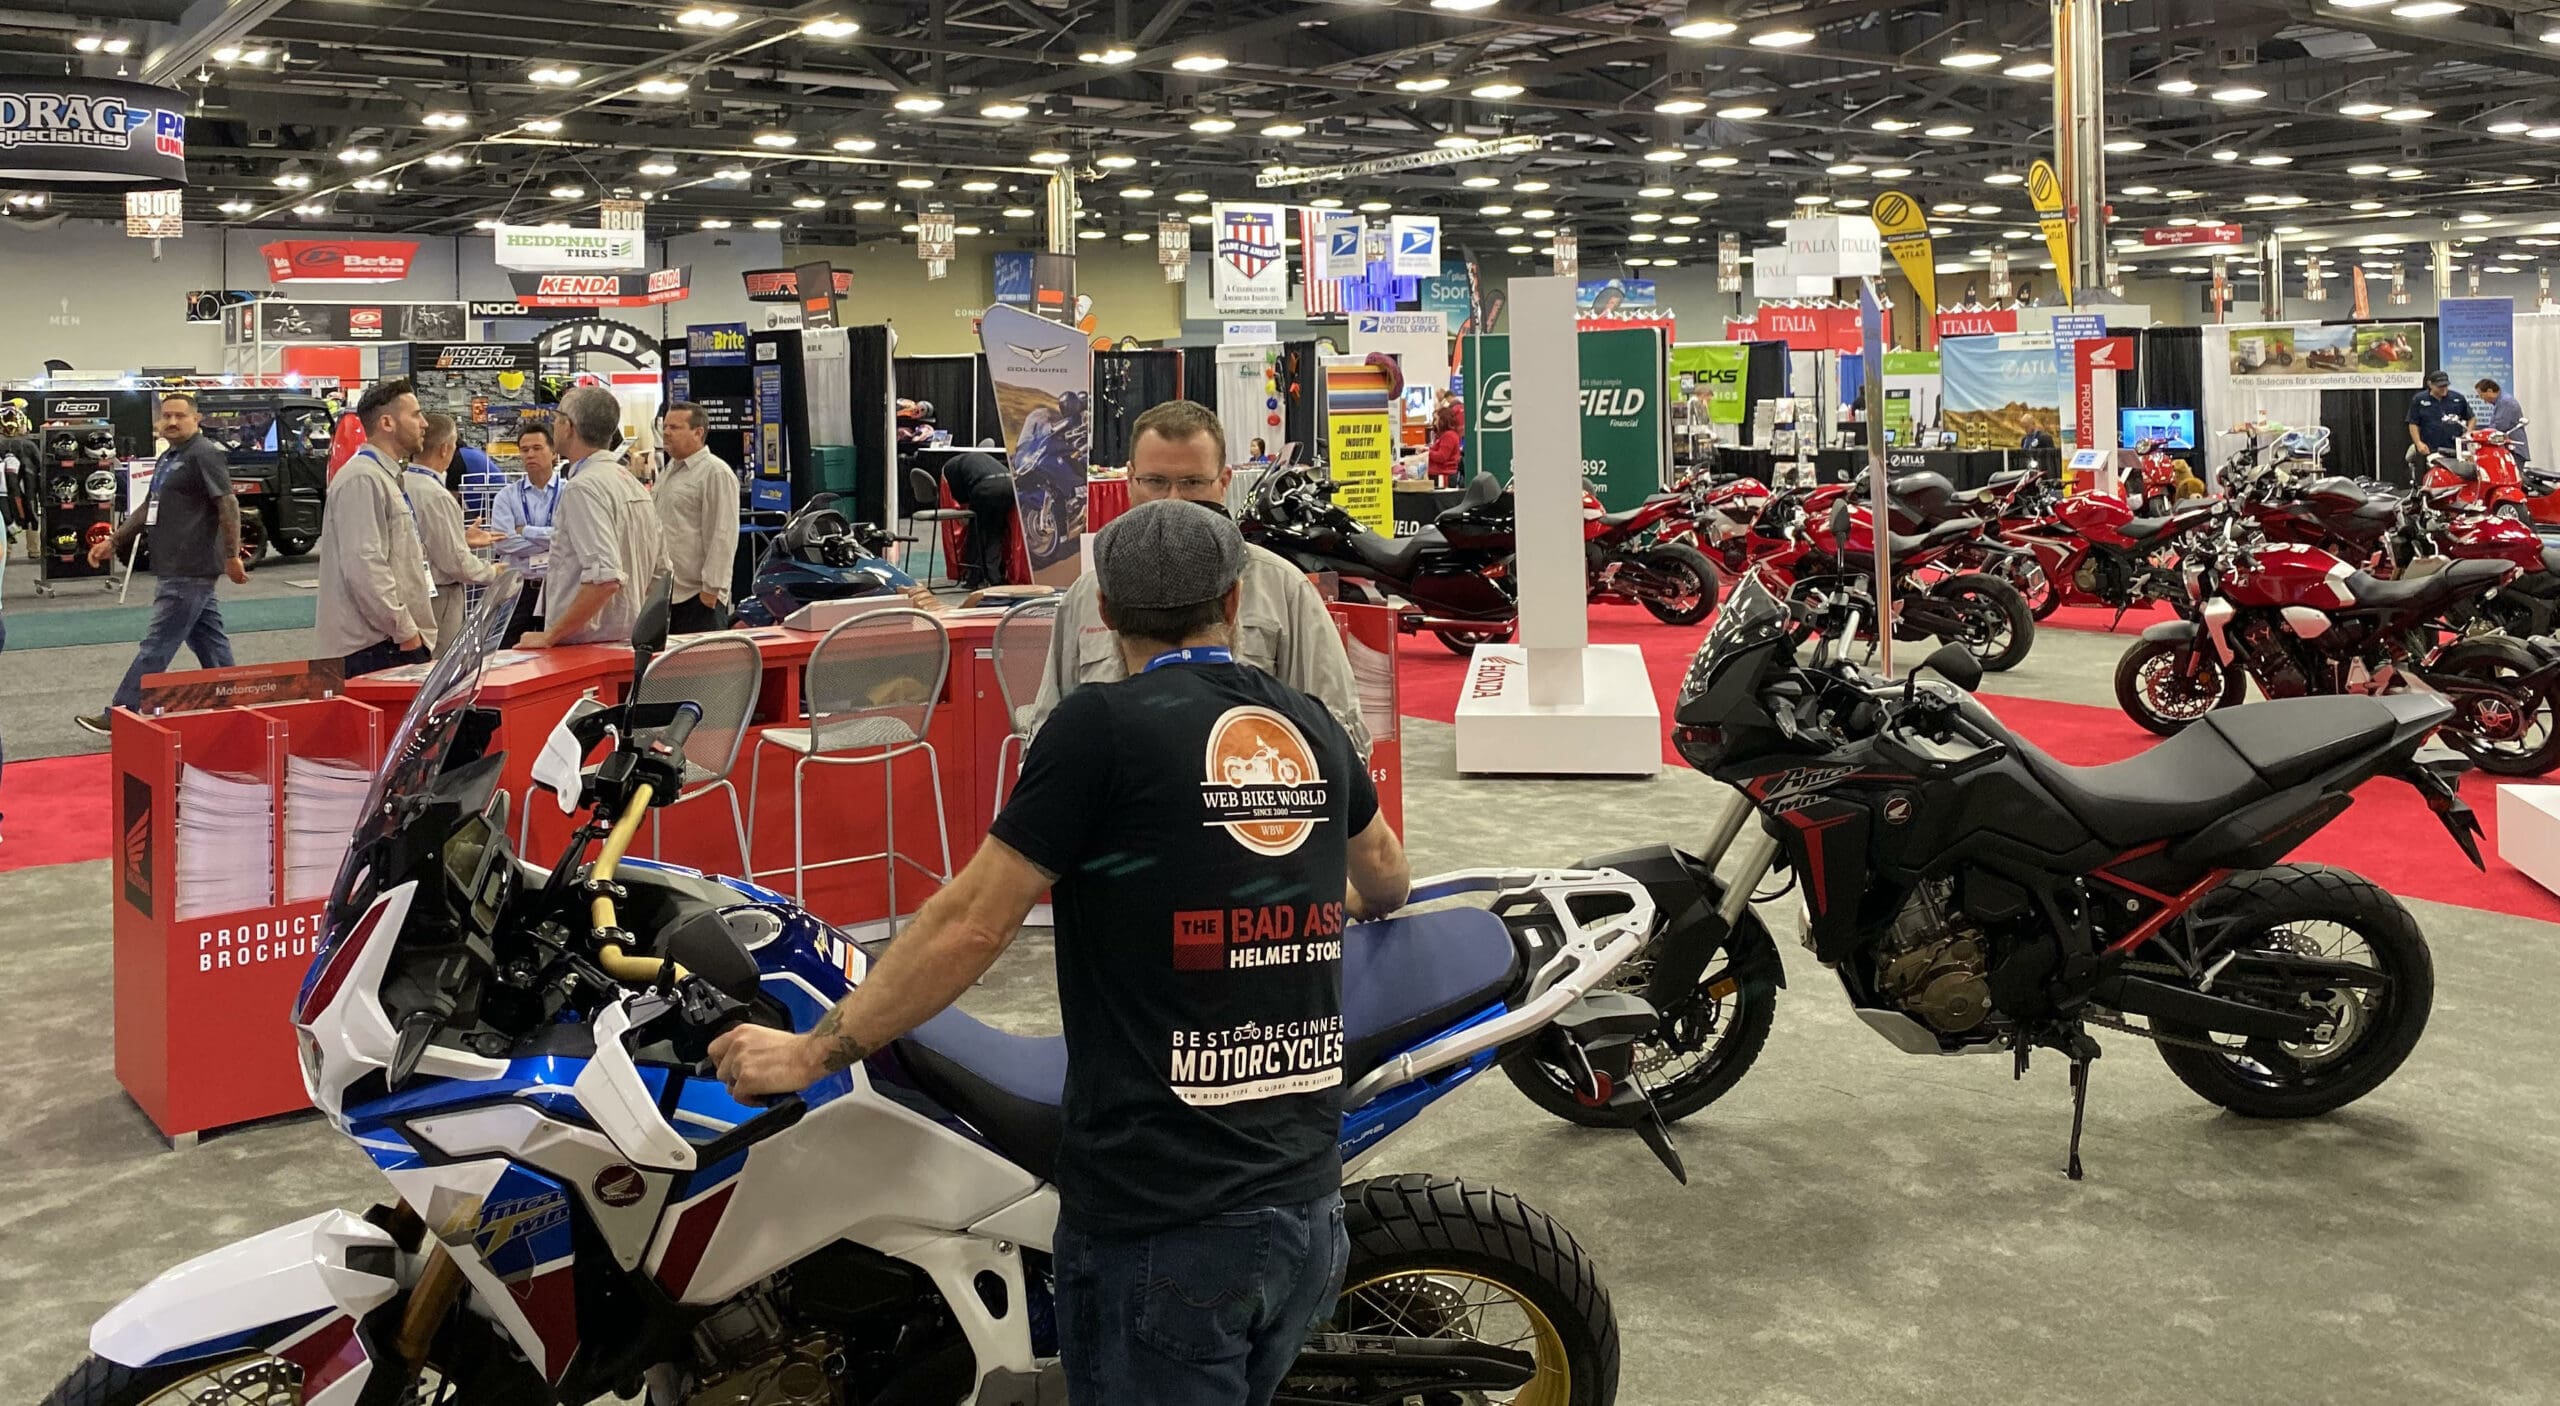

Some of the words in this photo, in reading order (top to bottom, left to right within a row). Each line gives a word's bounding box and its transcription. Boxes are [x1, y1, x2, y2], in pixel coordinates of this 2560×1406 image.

[0, 97, 126, 133] DRAG
[602, 210, 643, 230] 1800
[920, 224, 953, 242] 1700
[1160, 231, 1189, 249] 1600
[507, 234, 607, 248] HEIDENAU
[1367, 240, 1385, 254] 150
[1790, 239, 1837, 254] ITALIA
[1842, 238, 1878, 253] ITALIA
[343, 255, 404, 266] Beta
[565, 249, 608, 258] TIRES
[1900, 250, 1925, 260] ATLAS
[1756, 264, 1787, 280] ITALI
[537, 275, 619, 295] KENDA
[648, 268, 681, 293] KENDA
[1431, 282, 1470, 301] Spor
[472, 303, 528, 315] NOCO
[50, 316, 80, 326] MEN
[778, 315, 800, 325] Benell
[1381, 315, 1409, 324] UNITED
[1411, 315, 1438, 324] STATES
[1771, 315, 1816, 332] ITALIA
[1942, 318, 1994, 335] ITALIA
[1381, 325, 1409, 334] POSTAL
[1411, 325, 1440, 334] SERVICE
[1738, 328, 1758, 341] ITA
[442, 346, 504, 357] MOOSE
[540, 325, 661, 370] ENDA
[450, 356, 516, 368] RACING
[1007, 365, 1068, 374] GOLDWING
[2022, 360, 2058, 375] ATLA
[2256, 377, 2294, 385] Sidecars
[2295, 376, 2308, 384] for
[2309, 376, 2347, 385] scooters
[2373, 376, 2382, 384] to
[2081, 384, 2093, 441] PRODUCT
[1337, 425, 1352, 435] JOIN
[1352, 425, 1360, 434] US
[1361, 425, 1373, 434] FOR
[1373, 424, 1382, 433] AN
[1609, 419, 1638, 428] Financial
[1345, 437, 1374, 447] INDUSTRY
[1340, 450, 1380, 461] CELEBRATION!
[1901, 455, 1925, 465] ATLAS
[1472, 664, 1507, 699] HONDA
[216, 682, 277, 697] Motorcycle
[1202, 792, 1239, 808] WEB
[1242, 790, 1276, 807] BIKE
[1277, 789, 1327, 806] WORLD
[1253, 809, 1273, 817] SINCE
[1274, 808, 1289, 816] 2000
[1261, 825, 1285, 836] WBW
[1181, 919, 1216, 935] THE
[1232, 905, 1294, 943] BAD
[1304, 901, 1342, 937] ASS
[200, 915, 322, 950] PRODUCT
[1231, 944, 1301, 968] HELMET
[1173, 1031, 1230, 1048] BEST
[1265, 1015, 1344, 1040] BEGINNER
[1171, 1032, 1344, 1082] MOTORCYCLES
